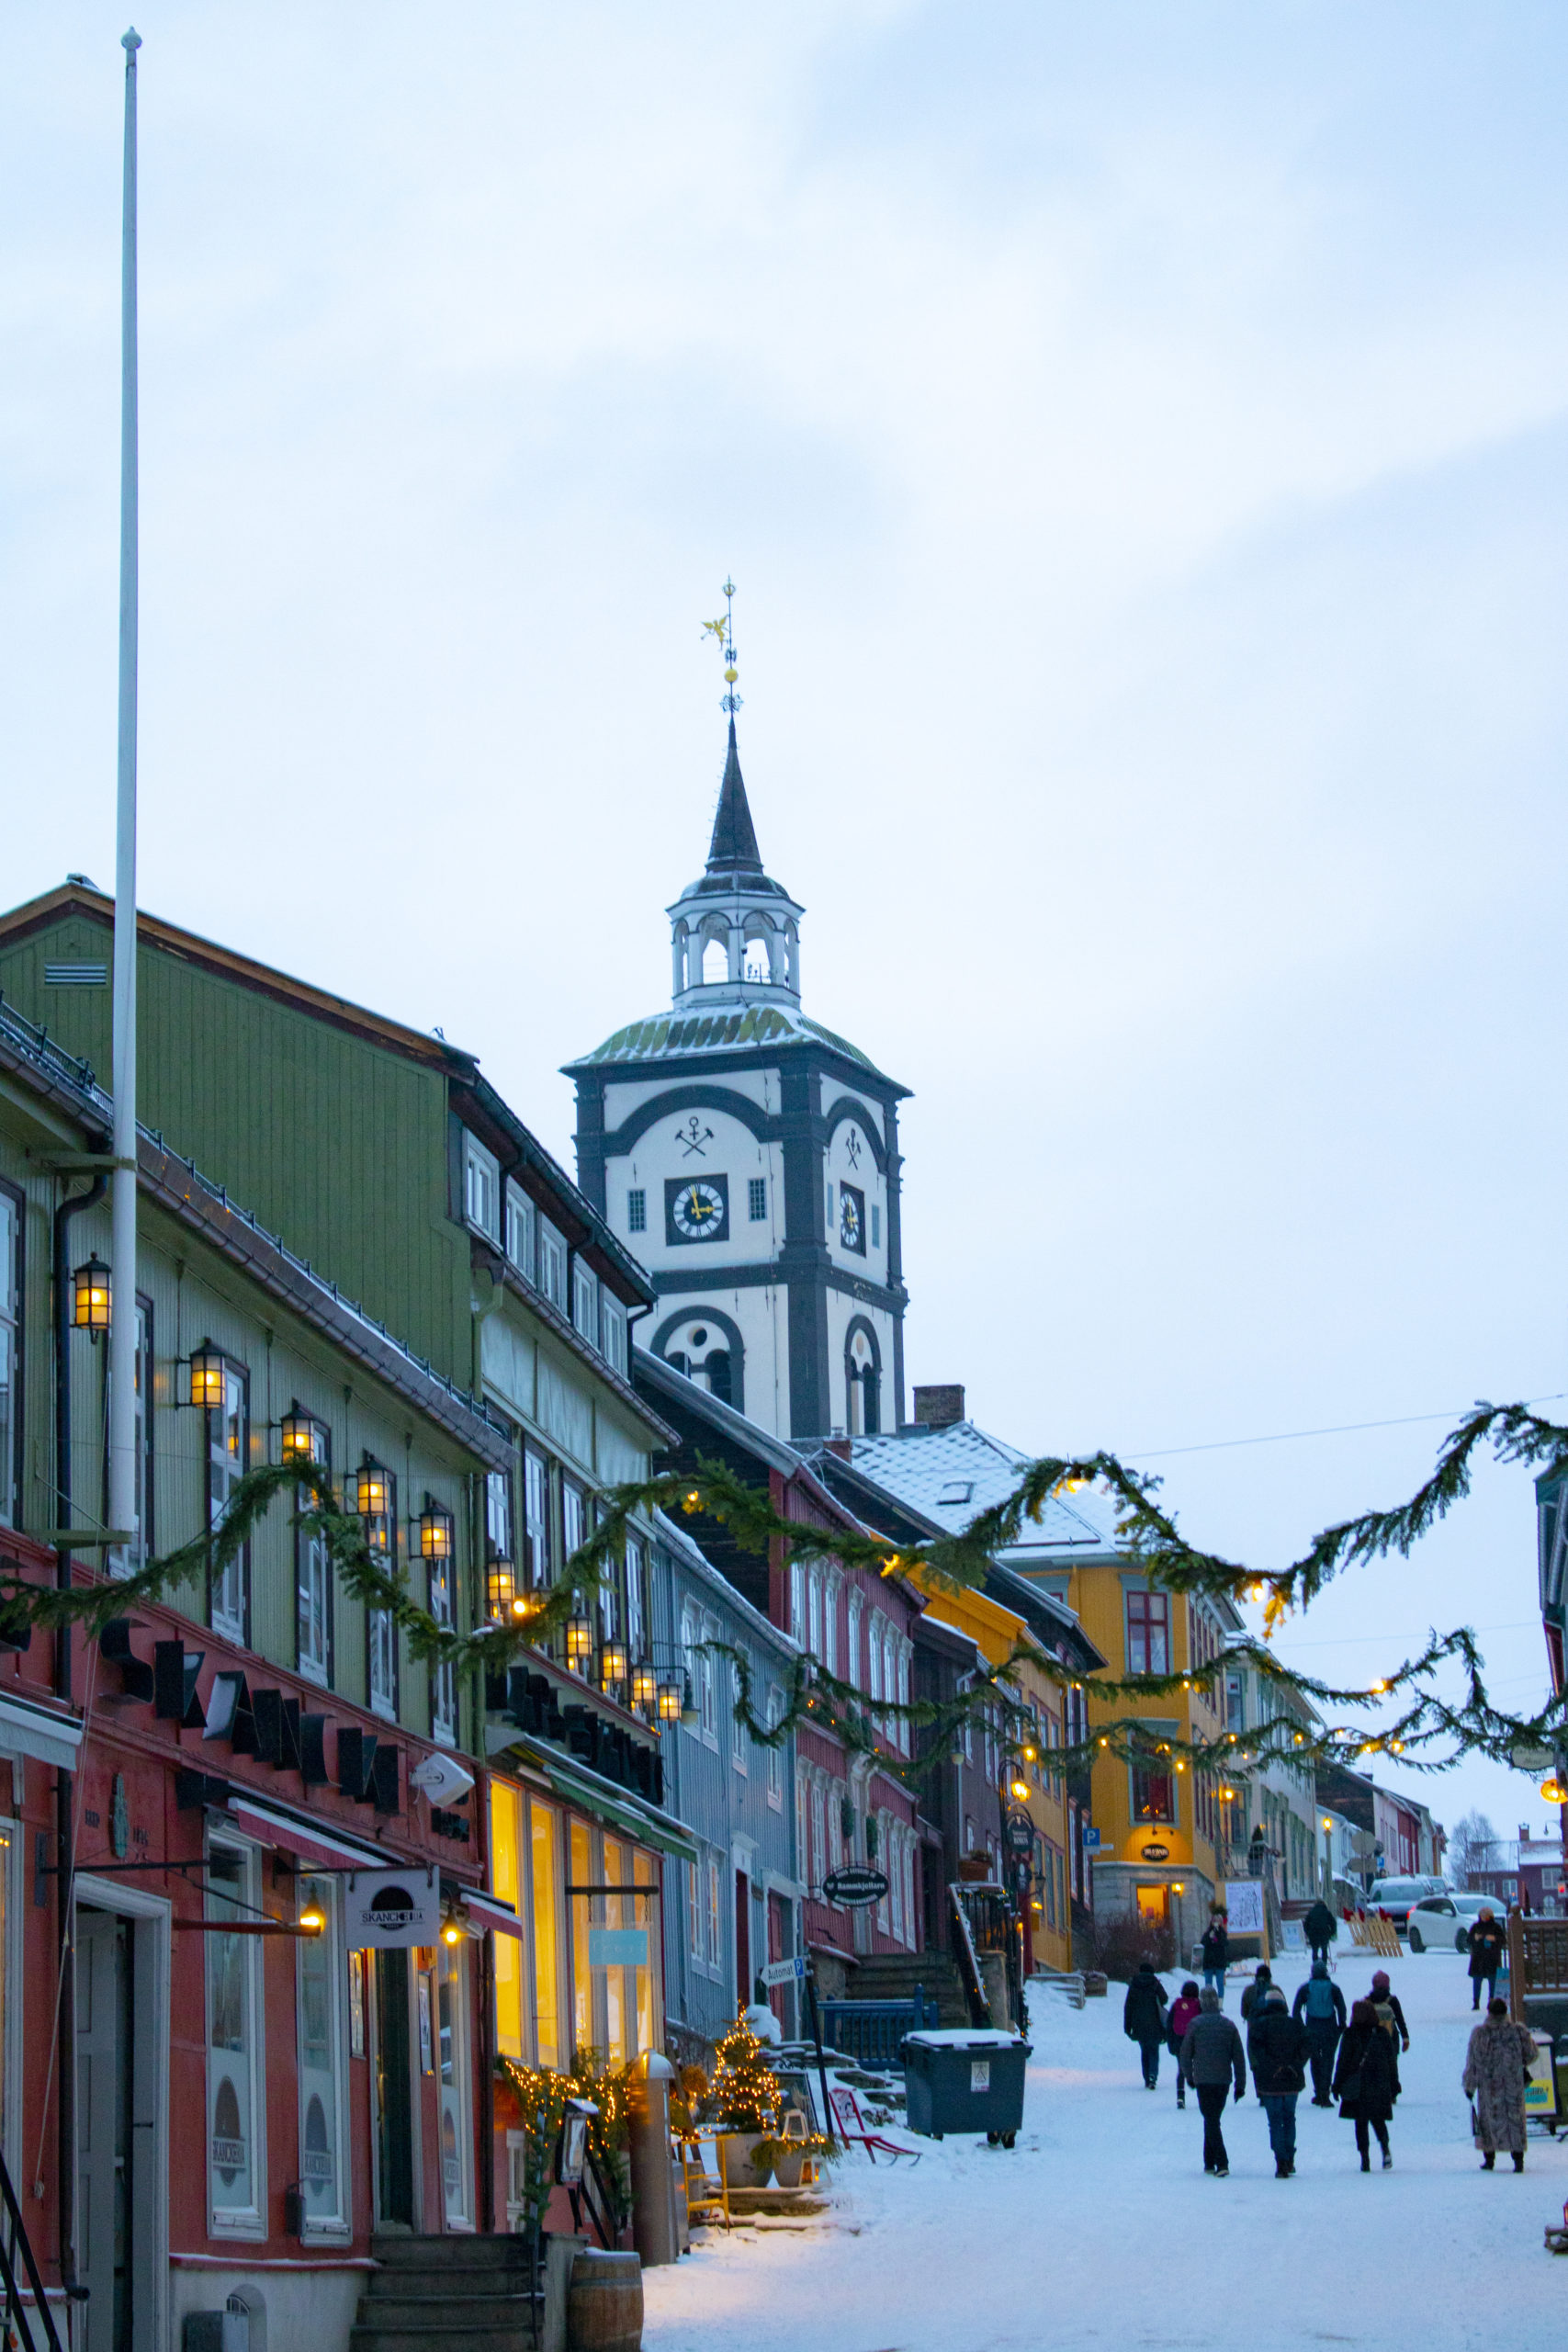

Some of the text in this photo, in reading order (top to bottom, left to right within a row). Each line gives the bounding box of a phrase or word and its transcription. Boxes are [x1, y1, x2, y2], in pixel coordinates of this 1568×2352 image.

[1087, 1830, 1096, 1844] P
[768, 1960, 801, 1981] Automat P
